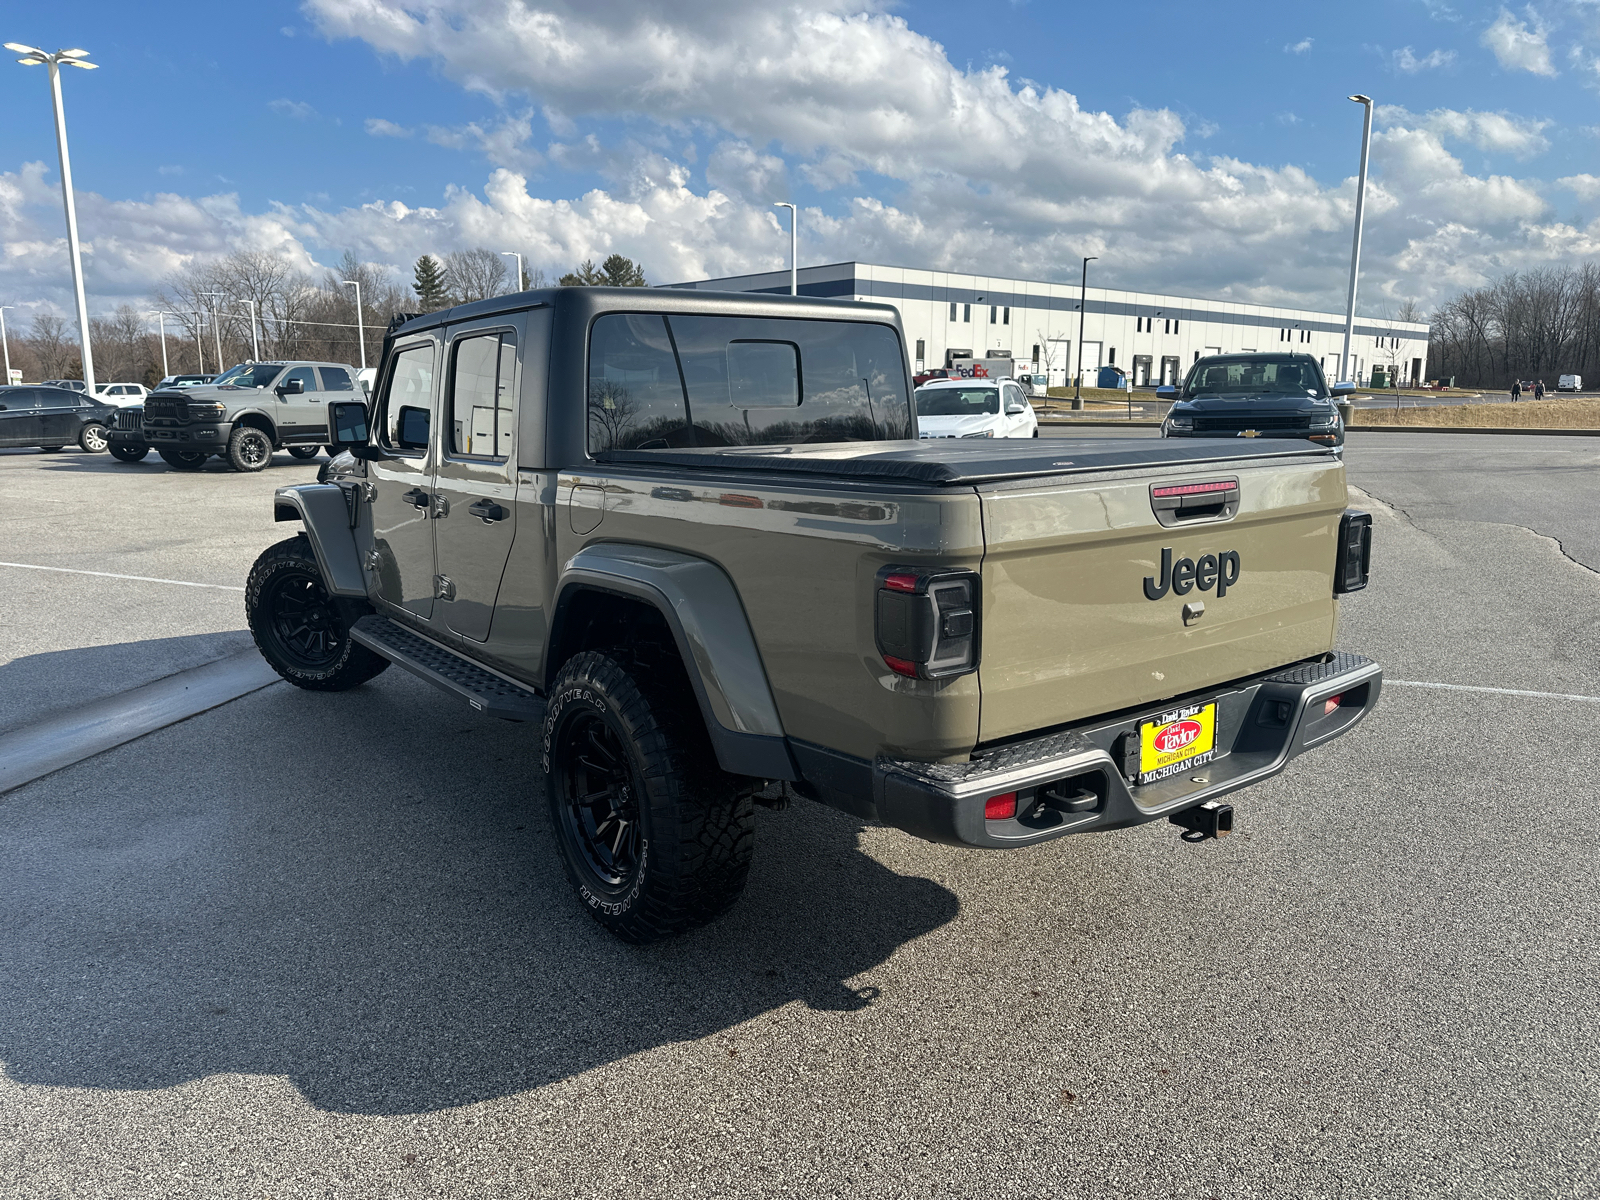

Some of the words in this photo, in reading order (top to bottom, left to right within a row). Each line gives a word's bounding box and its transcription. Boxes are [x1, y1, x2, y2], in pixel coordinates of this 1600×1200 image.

[956, 364, 989, 378] FedEx
[251, 560, 319, 608] GOODYEAR
[1143, 547, 1240, 601] Jeep
[1161, 711, 1178, 724] David
[1179, 706, 1199, 718] Taylor
[1167, 723, 1180, 735] David
[543, 688, 607, 774] GOODYEAR
[1161, 728, 1197, 750] Taylor
[1143, 758, 1192, 784] MICHIGAN
[1193, 750, 1214, 766] CITY
[1157, 750, 1183, 765] MICHIGAN
[1184, 746, 1196, 757] CITY
[580, 838, 649, 916] WRANGLER
